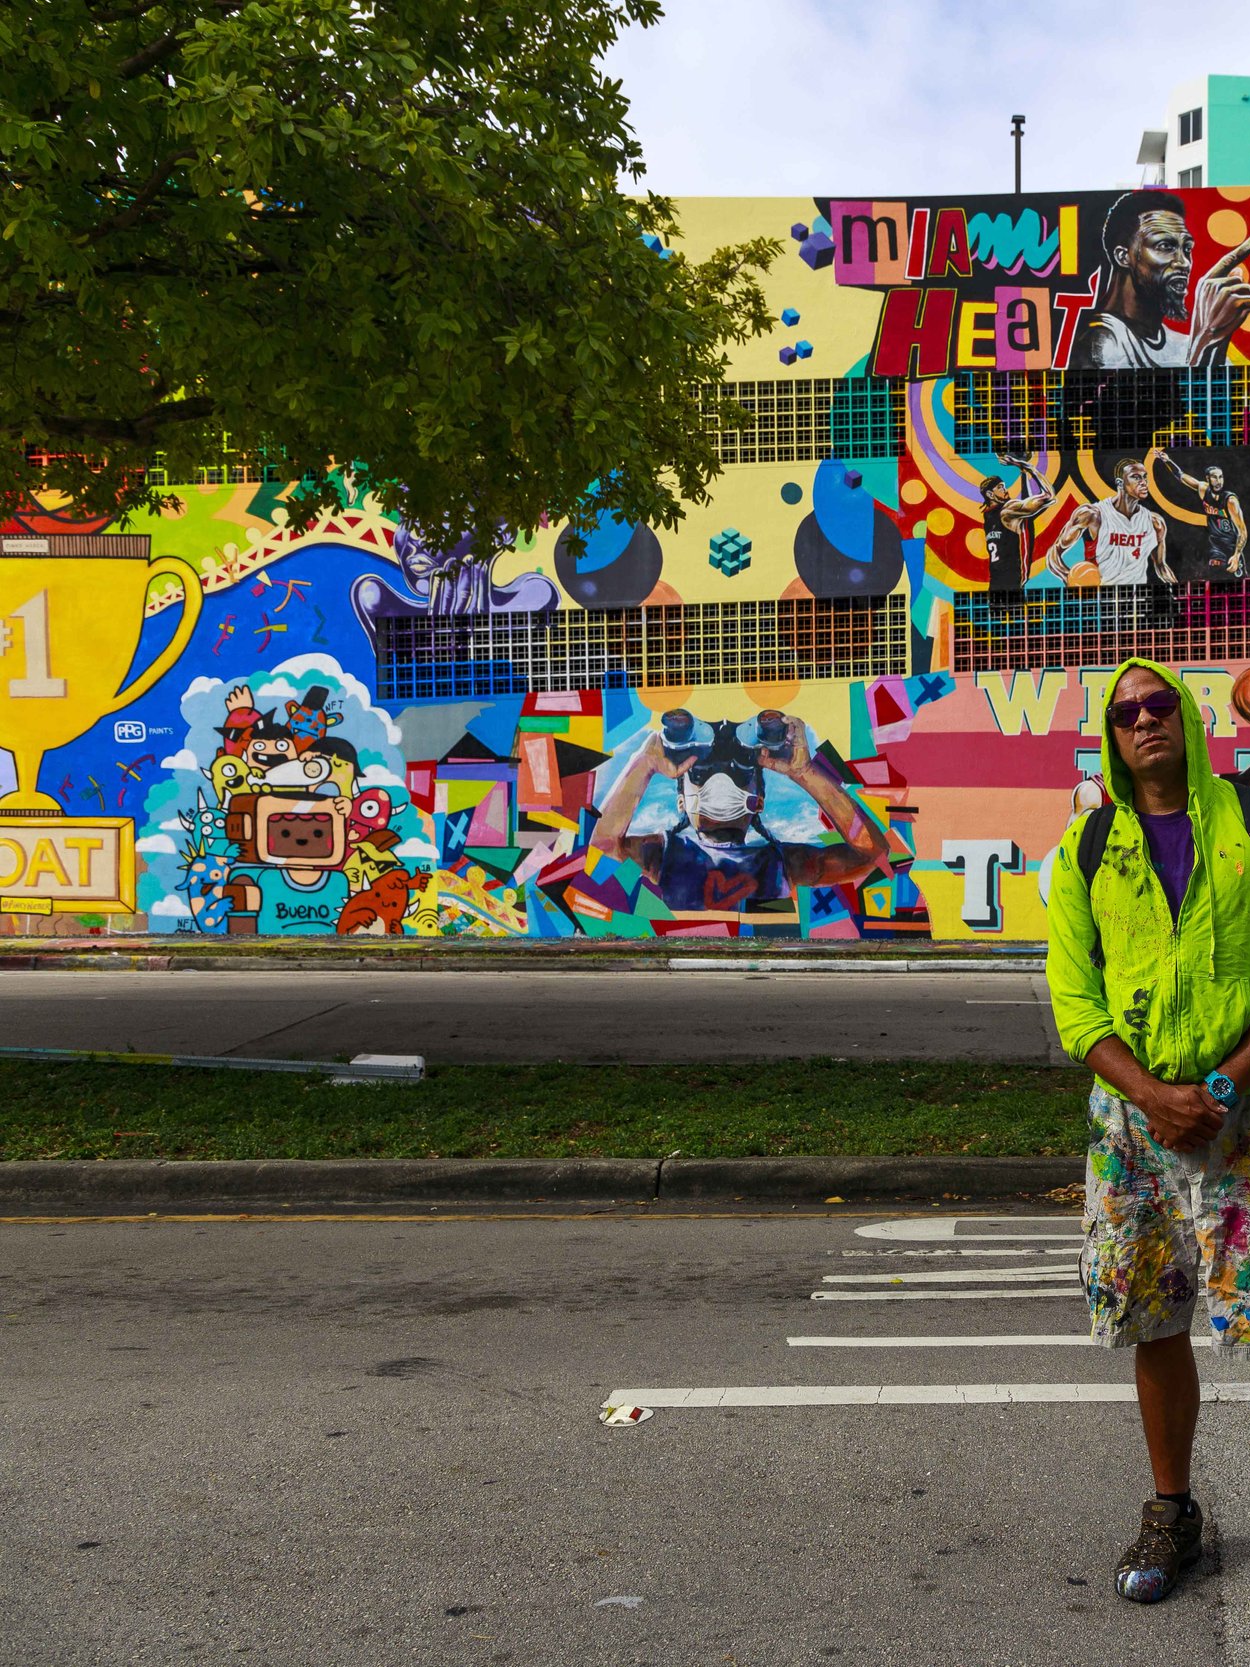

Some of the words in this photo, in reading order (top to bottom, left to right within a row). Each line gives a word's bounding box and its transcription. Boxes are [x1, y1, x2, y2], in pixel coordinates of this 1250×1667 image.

[1109, 531, 1147, 547] HEAT
[988, 542, 999, 562] 2
[1131, 547, 1141, 560] 4
[118, 724, 142, 738] PPG
[276, 902, 330, 919] Bueno
